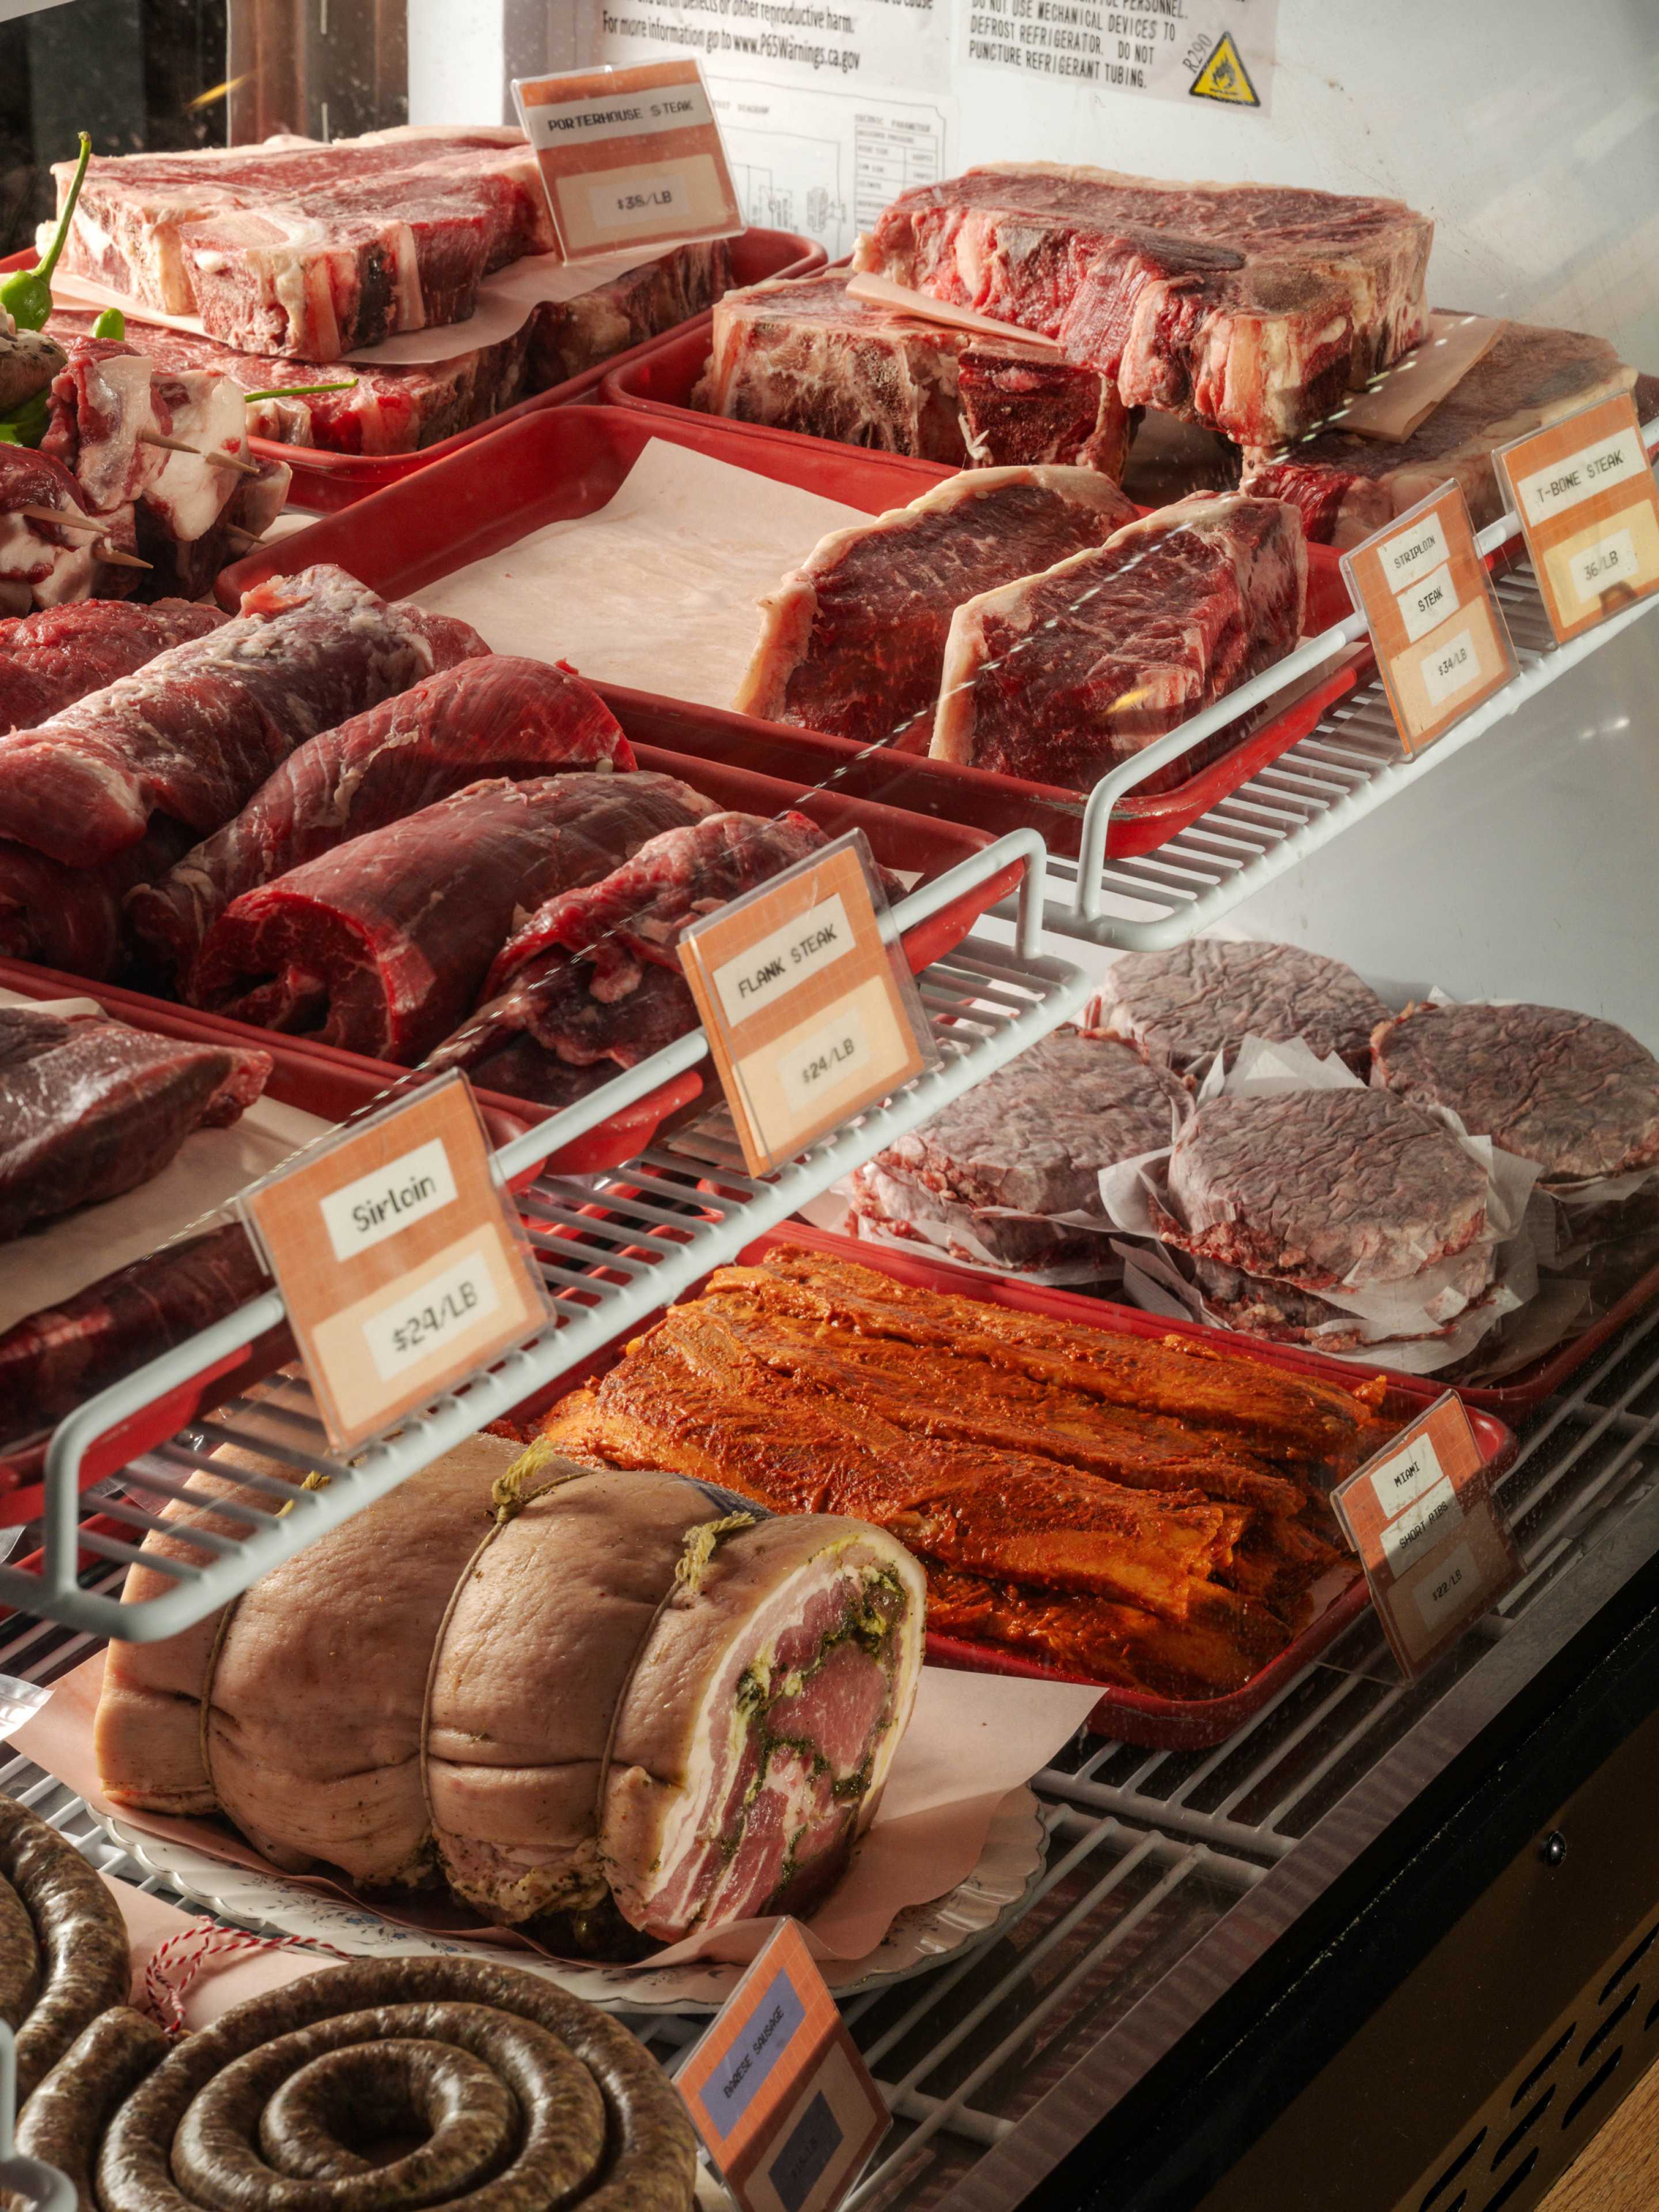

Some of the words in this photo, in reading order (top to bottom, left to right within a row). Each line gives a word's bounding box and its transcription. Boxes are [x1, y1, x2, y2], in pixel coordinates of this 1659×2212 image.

[761, 2, 824, 28] reproductive
[827, 6, 854, 33] harm.
[970, 15, 1015, 40] DEFROST
[1020, 24, 1104, 56] REFRIGERATOR.
[1118, 40, 1130, 60] DO
[1135, 43, 1155, 65] NOT
[1013, 0, 1032, 18] USE
[1037, 2, 1103, 31] MECHANICAL
[1108, 13, 1158, 40] DEVICES
[1164, 21, 1176, 41] TO
[603, 10, 618, 33] For
[620, 17, 646, 37] more
[648, 16, 704, 46] information
[706, 30, 719, 54] go
[721, 28, 731, 50] to
[733, 32, 859, 73] www.P65Warnings.ca.gov
[969, 39, 1022, 66] PUNCTURE
[1026, 50, 1100, 80] REFRIGERANT
[1104, 62, 1147, 89] TUBING.
[1182, 32, 1214, 75] R290
[548, 108, 644, 131] PORTERHOUSE
[650, 99, 694, 117] STEAK
[1536, 472, 1582, 503] T-BONE
[1586, 449, 1625, 479] STEAK
[1393, 535, 1436, 570] STRIPLOIN
[1584, 550, 1619, 581] 36/LB
[1418, 585, 1444, 612] STEAK
[1437, 647, 1468, 677] $34/LB
[738, 959, 786, 999] FLANK
[790, 923, 838, 964] STEAK
[802, 1037, 855, 1085] $24/LB
[352, 1176, 437, 1233] Sirloin
[1393, 1461, 1421, 1488] MIAMI
[1399, 1519, 1426, 1550] SHORT
[1429, 1500, 1449, 1525] RIBS
[753, 2005, 785, 2055] SAUSAGE
